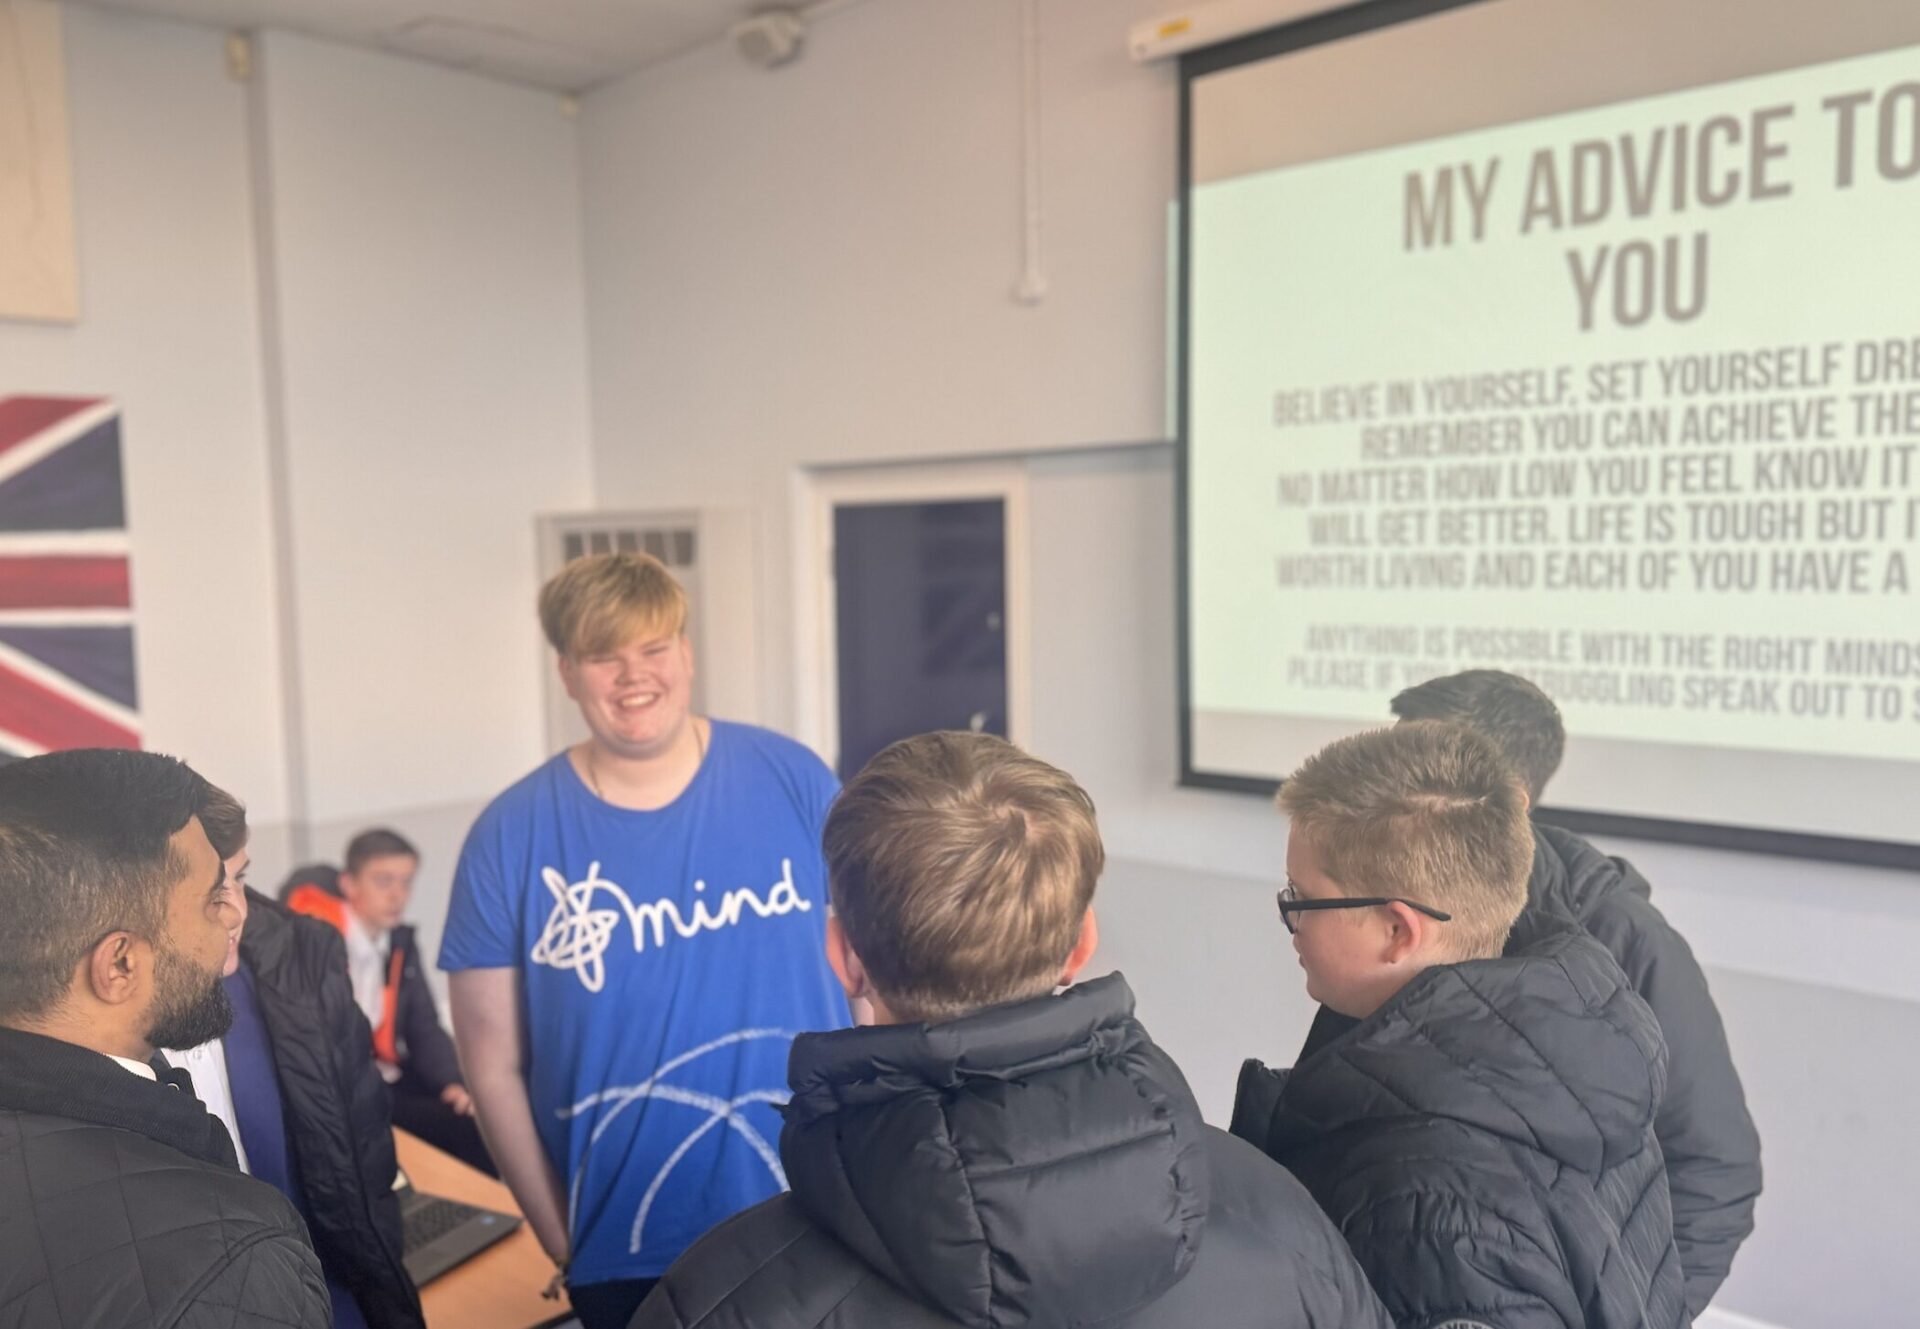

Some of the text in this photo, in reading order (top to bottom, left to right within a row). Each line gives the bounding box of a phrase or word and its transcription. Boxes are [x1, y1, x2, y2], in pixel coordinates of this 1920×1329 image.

[1403, 81, 1920, 252] MY ADVICE TO
[1565, 231, 1710, 333] YOU
[1273, 383, 1378, 428] BELIEVE
[1385, 379, 1415, 417] IN
[1587, 359, 1647, 403] SET
[1657, 342, 1843, 397] YOURSELF
[1361, 415, 1523, 461] REMEMBER
[1532, 411, 1594, 452] YOU
[1602, 405, 1669, 450] CAN
[1680, 396, 1838, 446] ACHIEVE
[1277, 444, 1917, 507] NO MATTER HOW LOW YOU FEEL KNOW IT
[1309, 512, 1370, 546] WILL
[1377, 509, 1429, 545] GET
[1437, 506, 1559, 545] BETTER.
[1568, 504, 1634, 543] LIFE
[1645, 502, 1676, 542] IS
[1686, 500, 1803, 542] TOUGH
[1817, 498, 1893, 541] BUT
[1277, 551, 1909, 593] WORTH LIVING AND EACH OF YOU HAVE A
[1306, 624, 1419, 654] ANYTHING
[1423, 626, 1446, 656] IS
[1455, 626, 1576, 662] POSSIBLE
[1581, 630, 1650, 666] WITH
[1660, 633, 1713, 670] THE
[1723, 635, 1816, 673] RIGHT
[1286, 656, 1368, 689] PLEASE
[1374, 659, 1392, 690] IF
[1682, 674, 1780, 715] SPEAK
[1789, 679, 1851, 717] OUT
[1861, 683, 1903, 722] TO
[625, 858, 811, 951] mind
